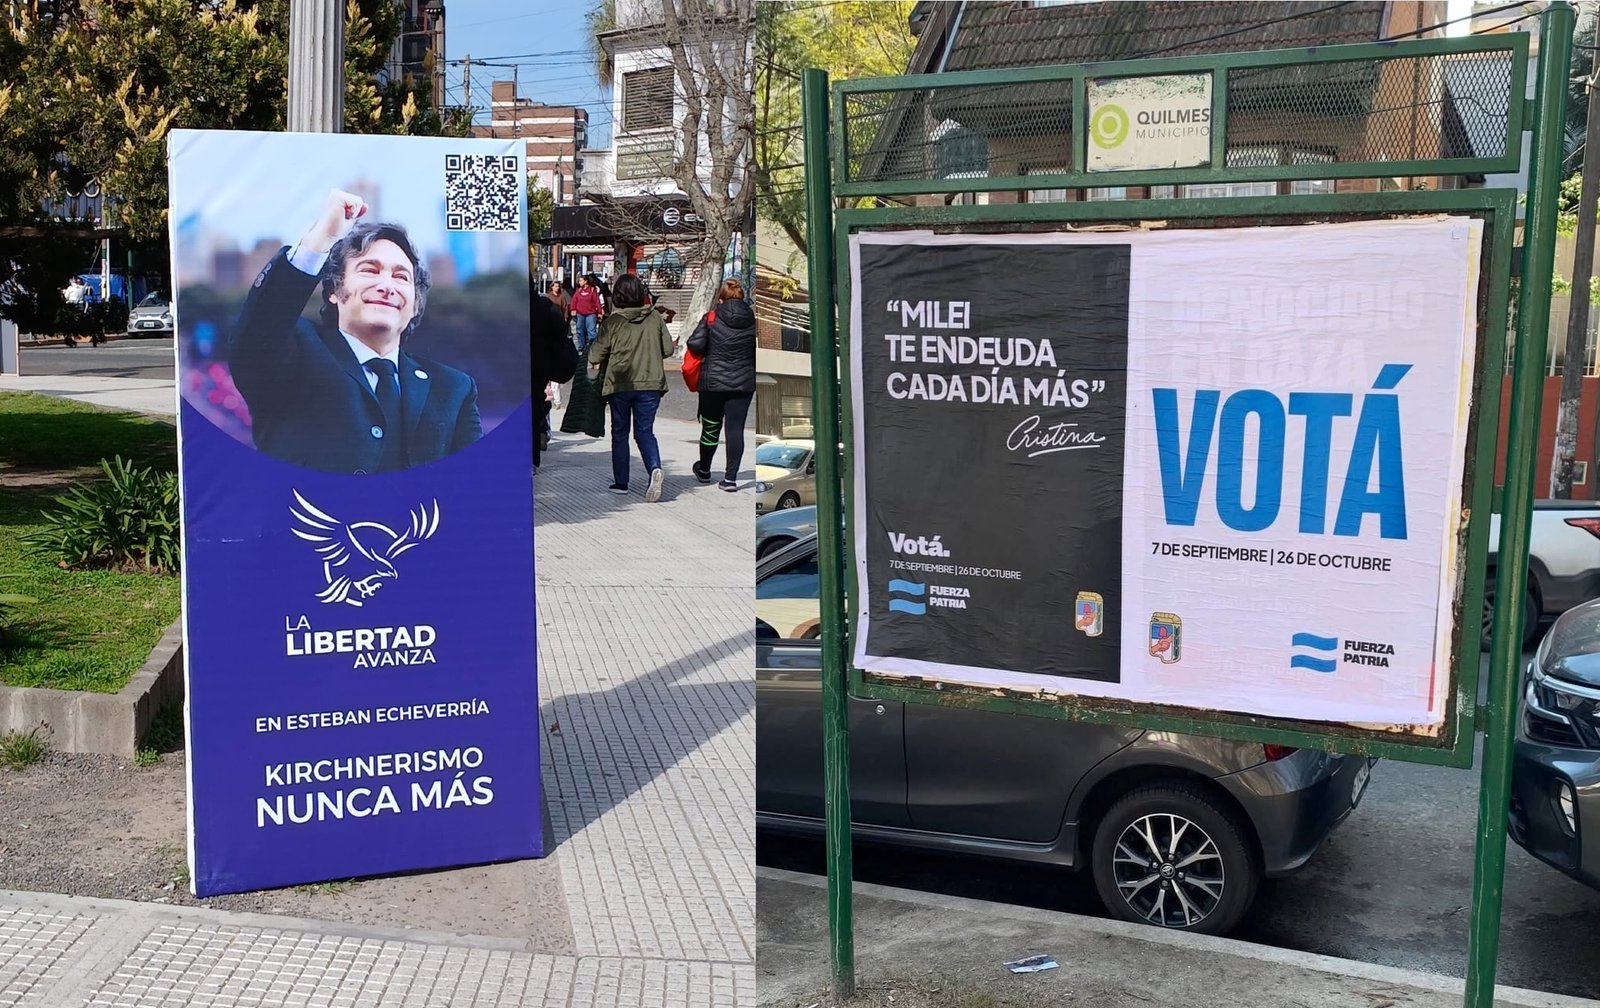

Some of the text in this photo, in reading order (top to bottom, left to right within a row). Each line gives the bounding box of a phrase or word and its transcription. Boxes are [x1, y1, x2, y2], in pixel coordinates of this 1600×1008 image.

[1137, 108, 1210, 125] QUILMES
[1136, 126, 1210, 139] MUNICIPIO
[884, 334, 1057, 367] TE ENDEUDA
[886, 372, 968, 402] CADA
[971, 367, 1020, 405] DÍA
[1006, 415, 1106, 455] Cristina
[1152, 364, 1414, 540] VOTÁ
[888, 531, 951, 557] Votá.
[1151, 542, 1392, 572] 7 DE SEPTIEMBRE 26 DE OCTUBRE
[889, 559, 1022, 580] 7 DE SEPTIEMBRE 26 DE OCTUBRE
[929, 585, 971, 598] FUERZA
[929, 596, 967, 609] PATRIA
[285, 614, 311, 631] LA
[285, 625, 437, 656] LIBERTAD
[1344, 640, 1395, 655] FUERZA
[353, 650, 436, 669] AVANZA
[1343, 652, 1390, 668] PATRIA
[256, 698, 490, 732] EN ESTEBAN ECHEVERRÍA
[265, 747, 484, 786] KIRCHNERISMO
[256, 771, 494, 827] NUNCA MÁS
